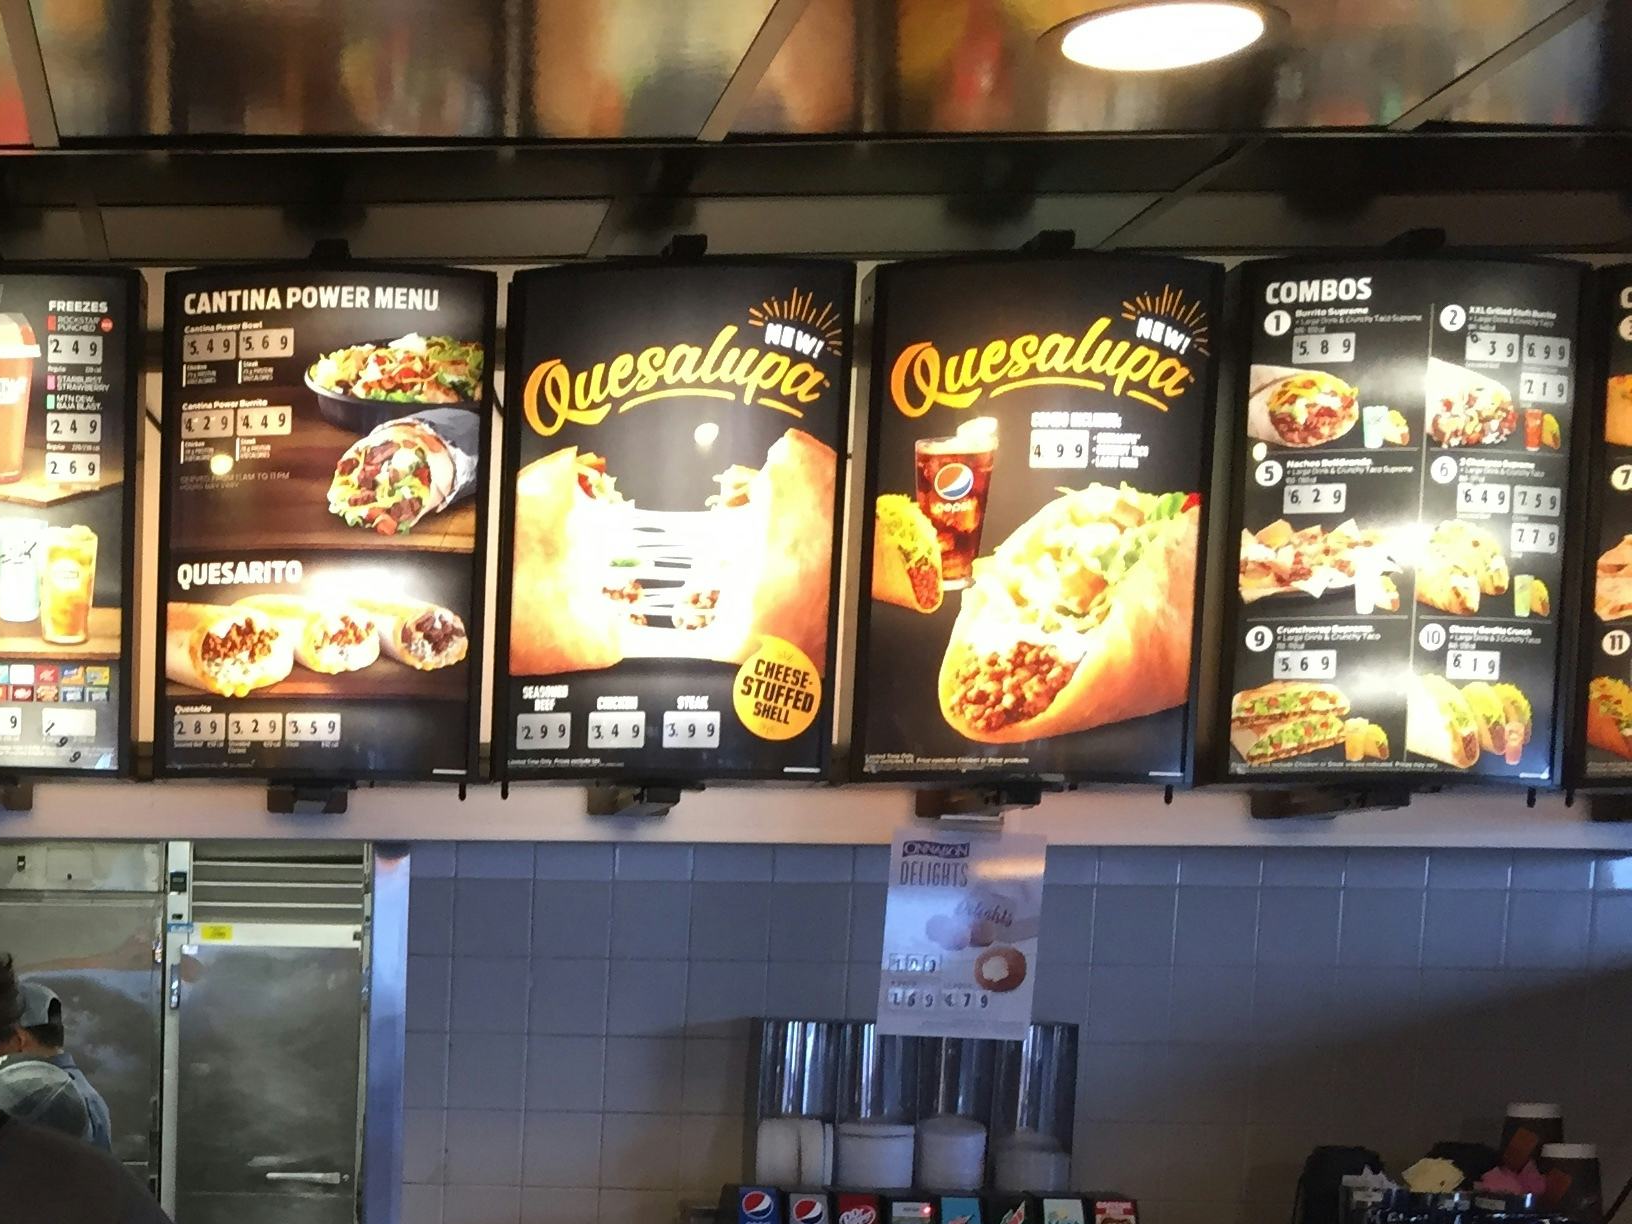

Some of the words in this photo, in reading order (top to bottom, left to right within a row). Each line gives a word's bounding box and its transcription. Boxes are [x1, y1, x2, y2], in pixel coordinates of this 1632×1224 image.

[184, 288, 281, 315] CANTINA
[286, 285, 369, 310] POWER
[374, 287, 439, 311] MENU
[1265, 276, 1373, 305] COMBOS
[48, 300, 108, 312] FREEZES
[1295, 309, 1327, 318] Burrito
[1328, 307, 1369, 317] Supreme
[184, 325, 215, 334] Cantina
[216, 323, 241, 331] Power
[242, 321, 263, 330] Bowl
[764, 322, 826, 360] NEW!
[1135, 316, 1192, 356] NEW!
[523, 325, 826, 437] Quesalupa
[890, 317, 1188, 418] Quesalupa
[182, 402, 212, 411] Cantina
[213, 401, 238, 409] Power
[239, 399, 268, 407] Burrito
[177, 560, 303, 590] QUESARITO
[740, 677, 814, 715] STUFFED
[753, 701, 792, 725] SHELL
[900, 860, 969, 887] DELIGHTS
